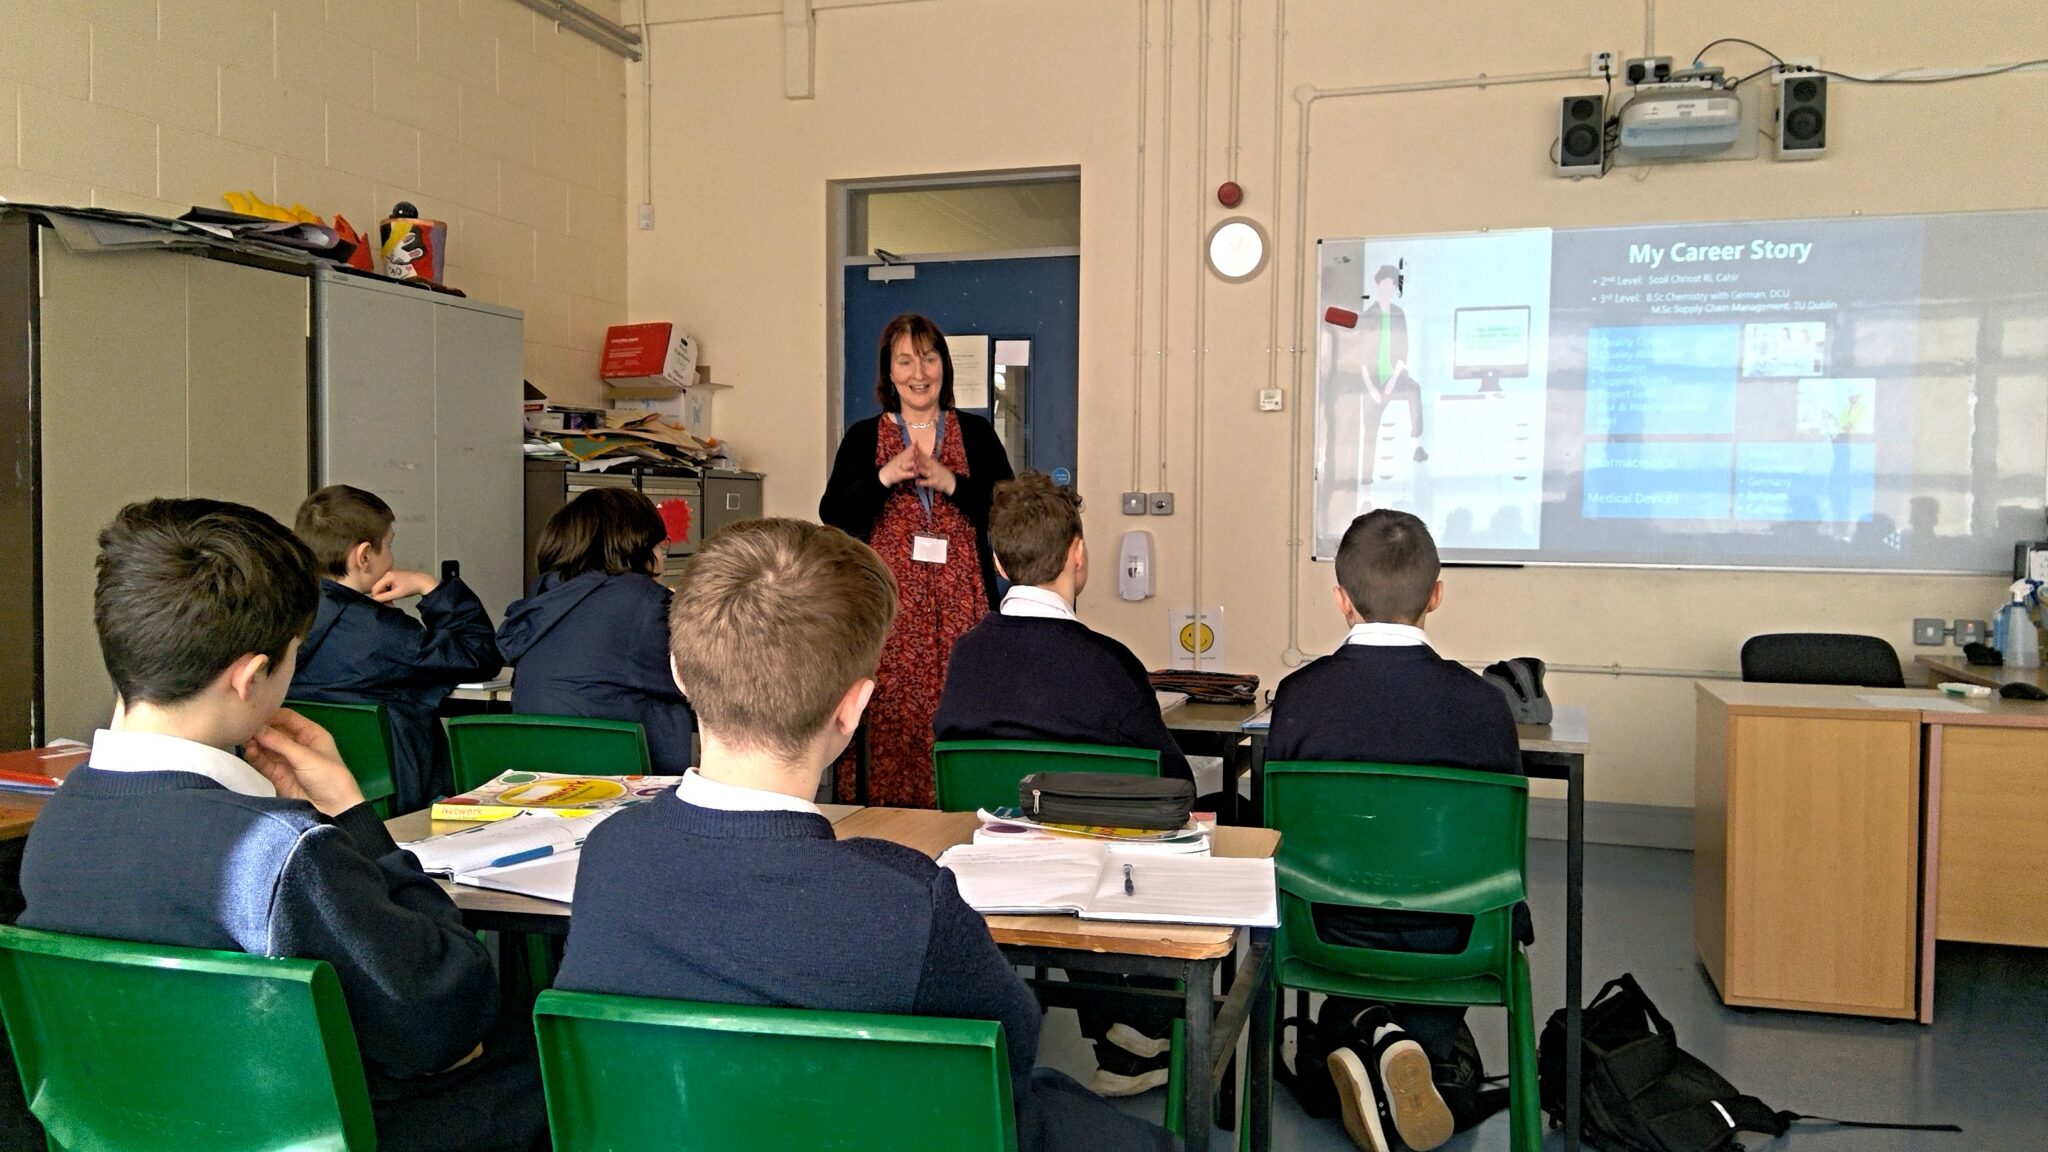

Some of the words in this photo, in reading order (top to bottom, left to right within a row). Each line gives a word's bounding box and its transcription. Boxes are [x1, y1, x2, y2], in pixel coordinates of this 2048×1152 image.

[1629, 243, 1664, 268] My
[1670, 242, 1744, 262] Career
[1750, 239, 1813, 264] Story
[1666, 291, 1707, 302] Chemistry
[1710, 291, 1729, 300] with
[1769, 288, 1790, 298] DCU
[1674, 304, 1702, 314] Supply
[1705, 303, 1729, 312] Chain
[1807, 300, 1838, 309] Dublin
[1588, 492, 1632, 504] Medical
[1634, 492, 1679, 504] Devices
[441, 807, 483, 816] Network
